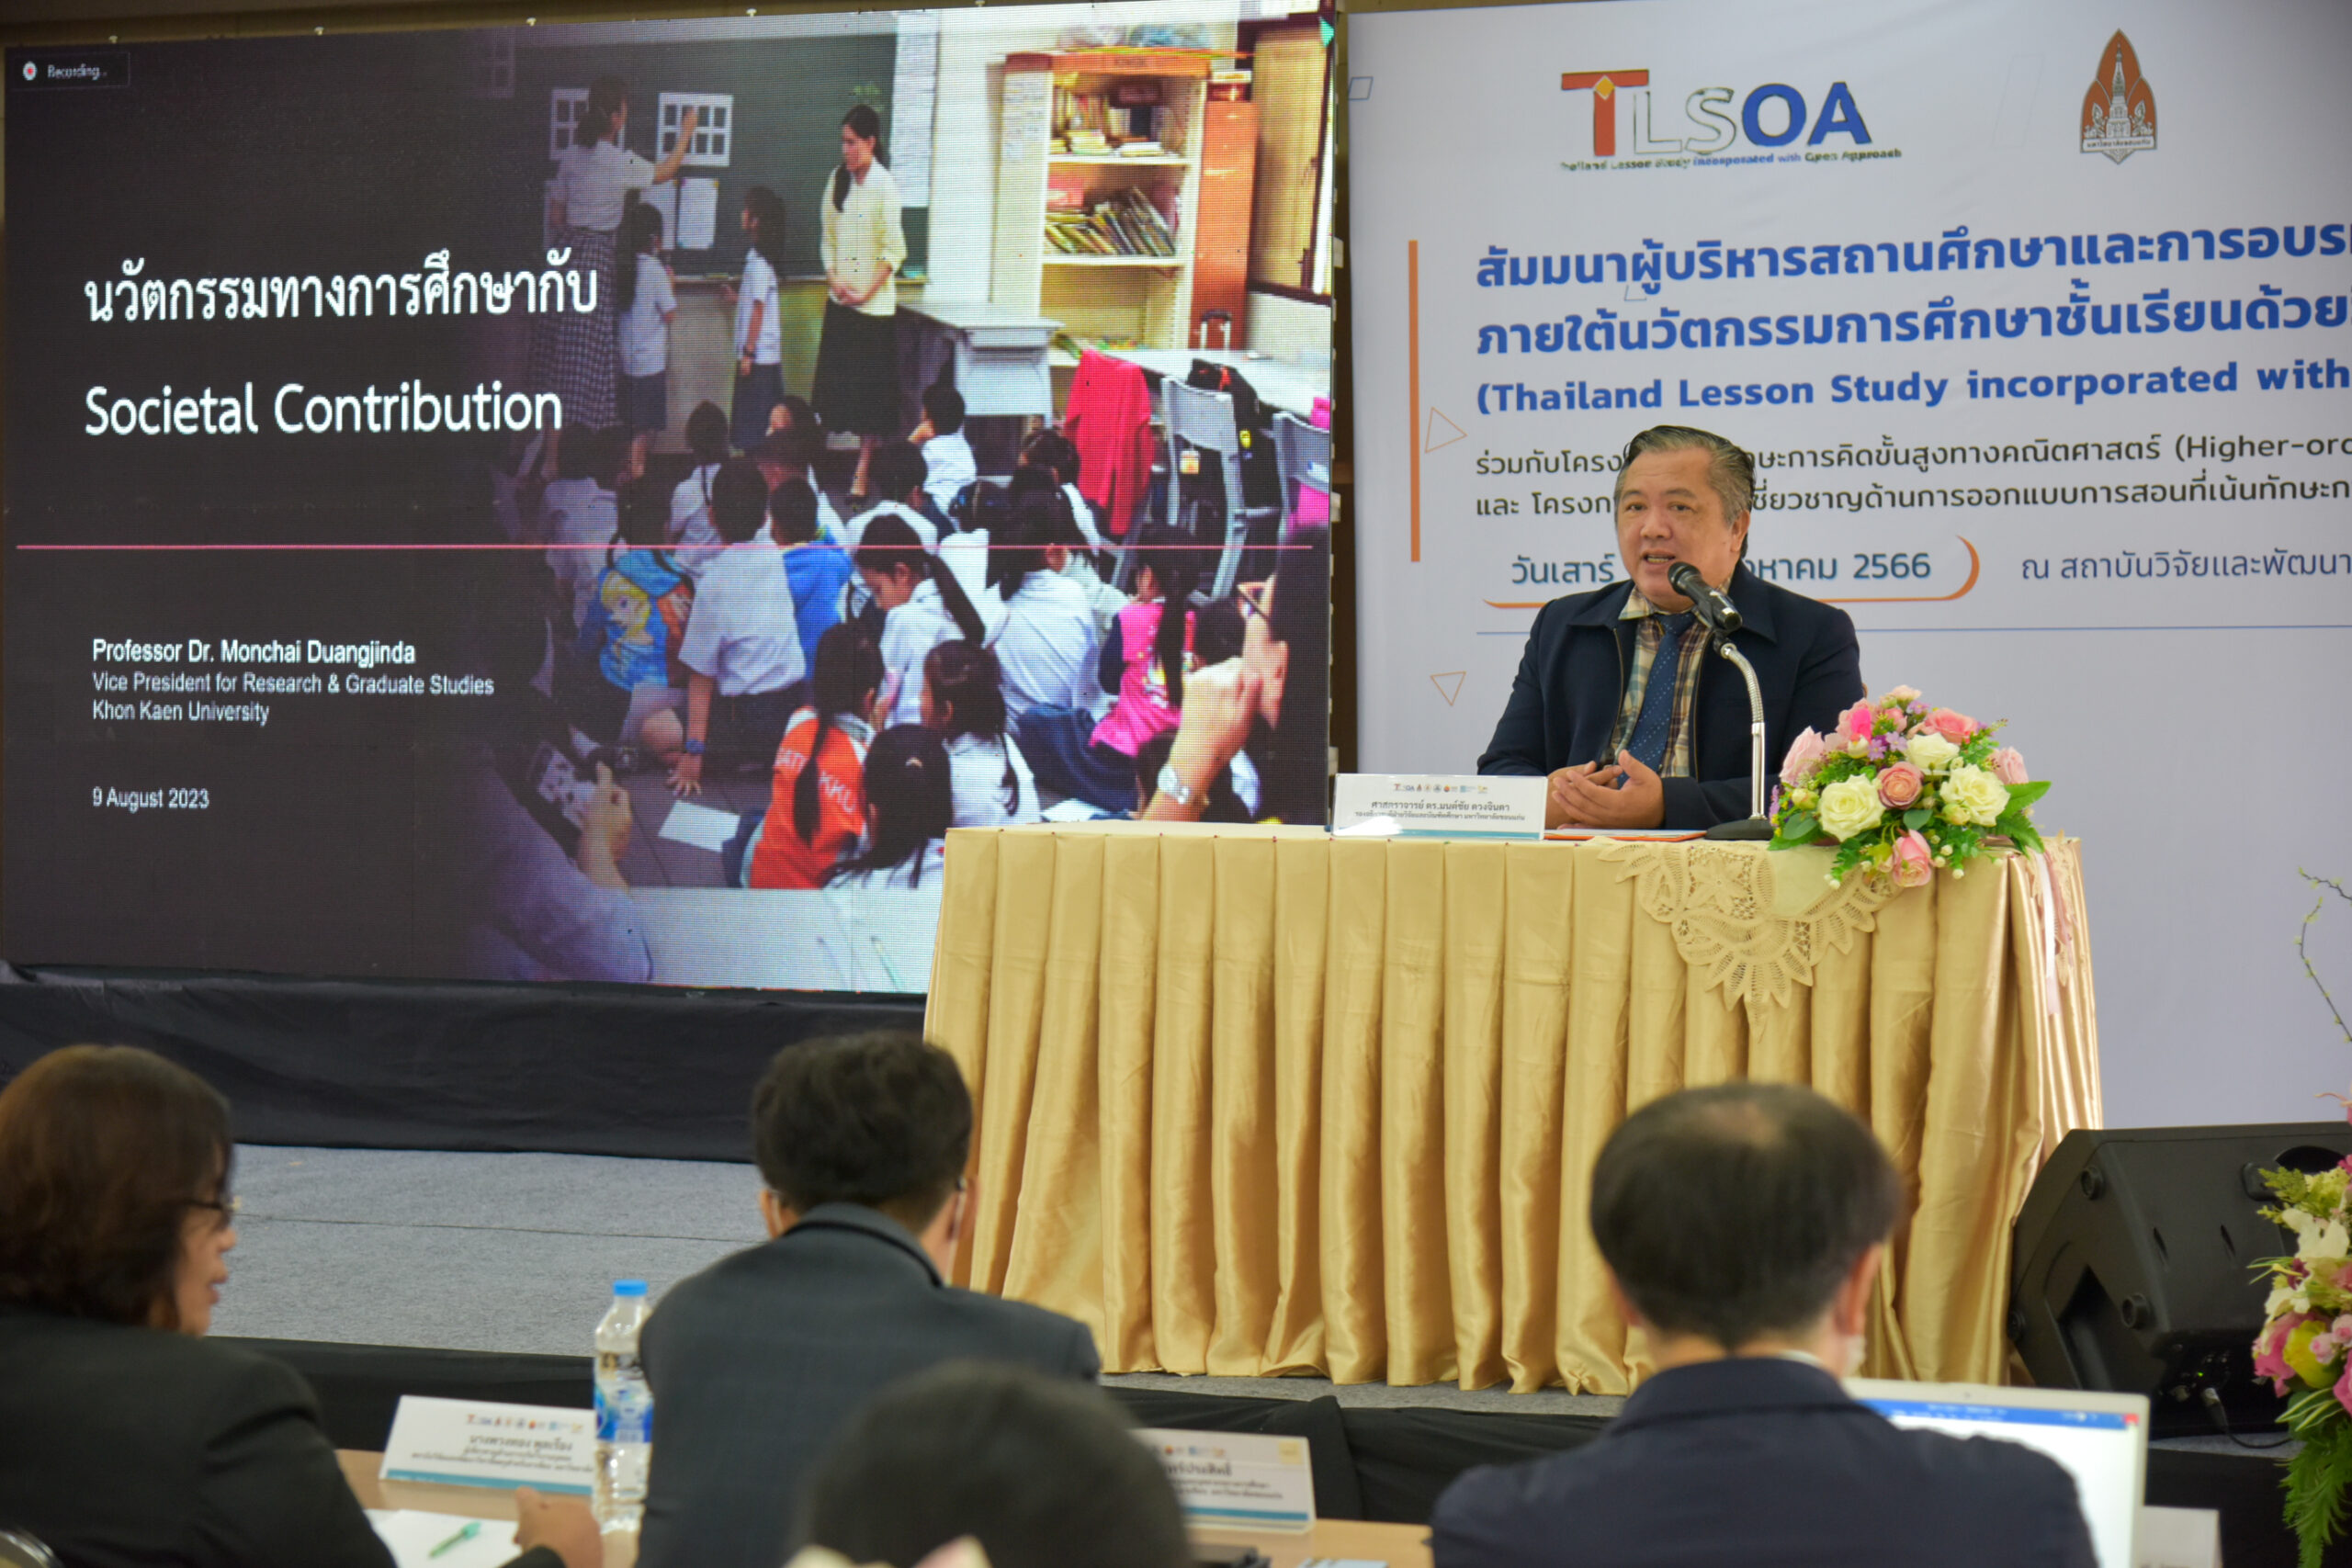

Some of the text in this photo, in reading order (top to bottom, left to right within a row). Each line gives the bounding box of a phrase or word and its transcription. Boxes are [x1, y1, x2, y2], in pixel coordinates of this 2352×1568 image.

[1560, 69, 1872, 157] TLSOA
[1693, 153, 1775, 168] incorporated
[1778, 152, 1801, 164] with
[1476, 223, 2352, 295] สัมมนาผู้บริหารสถานศึกษาและการอบร
[84, 247, 598, 322] นวัตกรรมทางการศึกษากับ
[1477, 277, 2352, 355] ภายใต้นวัตกรรมการศึกษาชั้นเรียนด้วย
[1477, 358, 2350, 415] (Thailand Lesson Study incorporated with
[85, 378, 562, 434] Societal Contribution
[1476, 447, 1623, 476] ร่วมกับโครง
[1476, 491, 1613, 516] และ โครงก
[1752, 469, 2352, 512] ชี่ยวชาญด้านการออกแบบการสอนที่เน้นทักษะก
[1511, 553, 1616, 585] วันเสาร์
[1852, 553, 1931, 580] 2566
[2022, 547, 2352, 580] ณ สถาบันวิจัยและพัฒนา
[93, 638, 416, 669] Professor Dr. Monchai Duangjinda
[93, 671, 495, 696] Vice President for Research & Graduate Studies
[93, 699, 269, 727] Khon Kaen University
[93, 786, 209, 814] 9 August 2023
